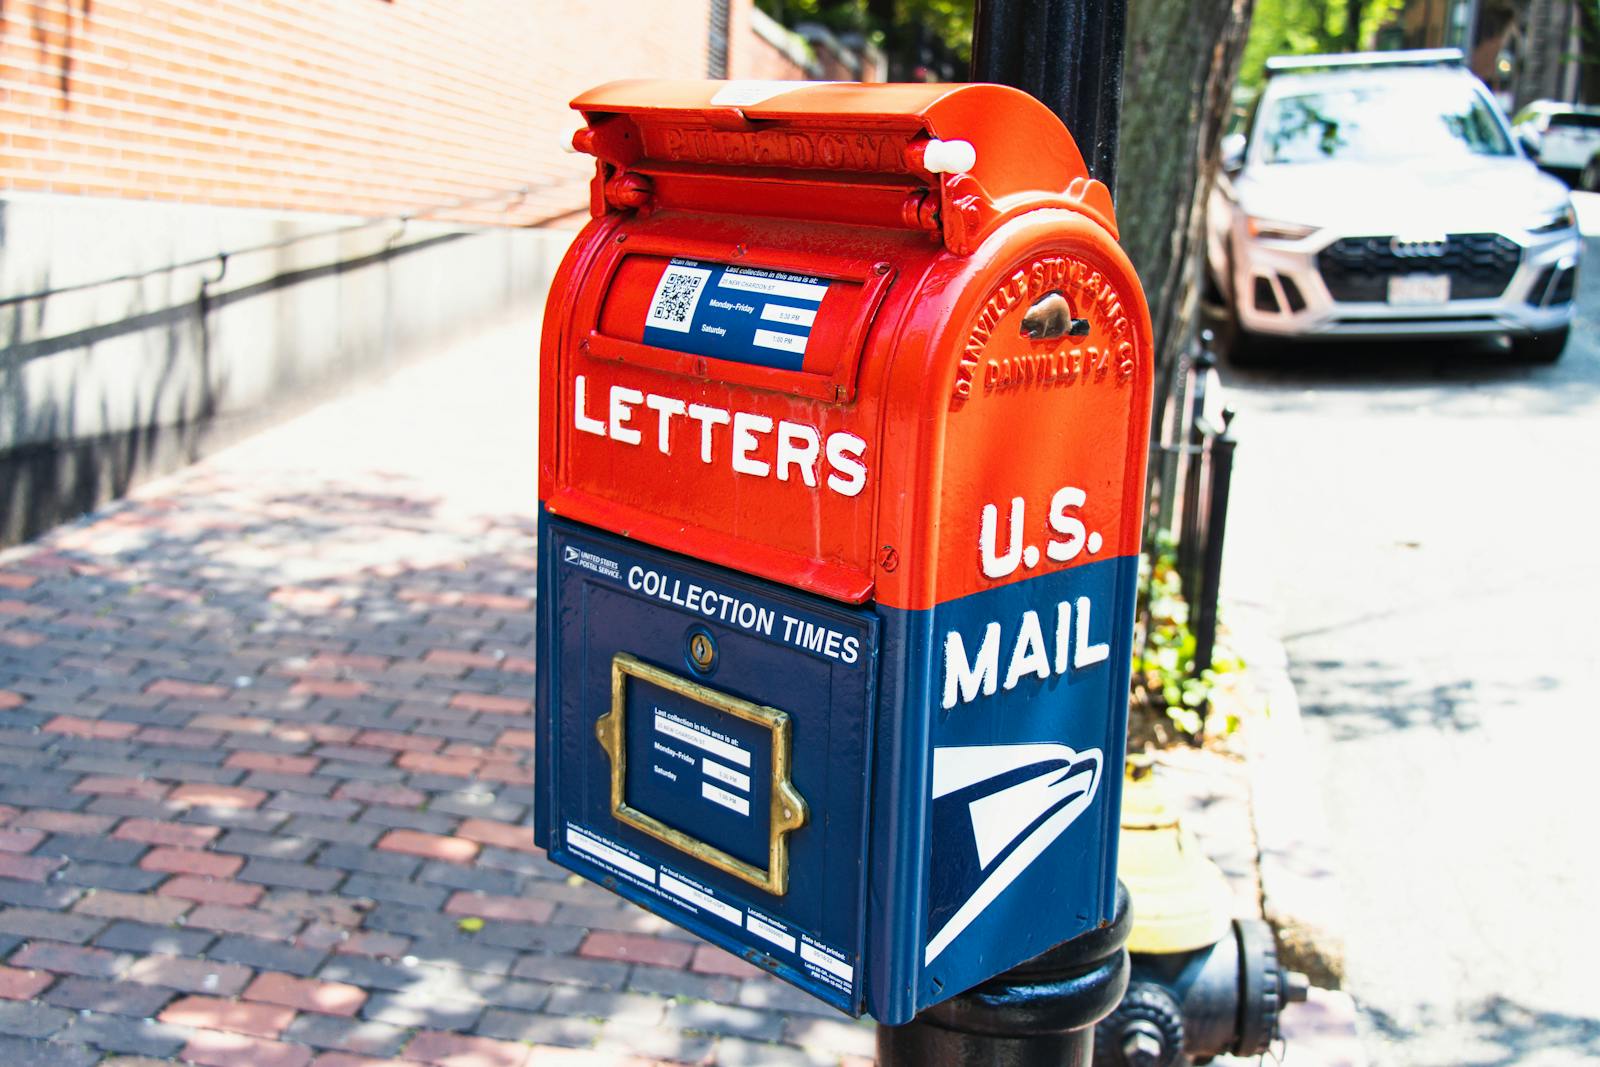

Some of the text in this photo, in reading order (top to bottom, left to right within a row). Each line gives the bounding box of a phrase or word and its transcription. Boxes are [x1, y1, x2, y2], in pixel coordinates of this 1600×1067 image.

[726, 265, 740, 273] Last
[739, 267, 769, 278] collection
[774, 271, 787, 281] this
[787, 274, 802, 283] area
[802, 275, 809, 283] is
[808, 276, 819, 285] at:
[701, 323, 727, 337] Saturday
[956, 270, 1029, 394] DANVILLE
[1030, 256, 1087, 284] STOVE
[987, 349, 1082, 384] DANVILLE
[574, 375, 868, 497] LETTERS
[979, 486, 1103, 578] U.S.
[580, 551, 619, 570] UNITED STATES
[580, 559, 598, 572] POSTAL
[628, 565, 860, 664] COLLECTION TIMES
[941, 596, 1109, 710] MAIL
[654, 706, 667, 717] Last
[667, 713, 694, 727] collection
[694, 722, 700, 730] in
[700, 725, 711, 735] this
[711, 730, 725, 741] area
[725, 734, 731, 743] is
[731, 737, 739, 746] at:
[654, 764, 677, 782] Saturday
